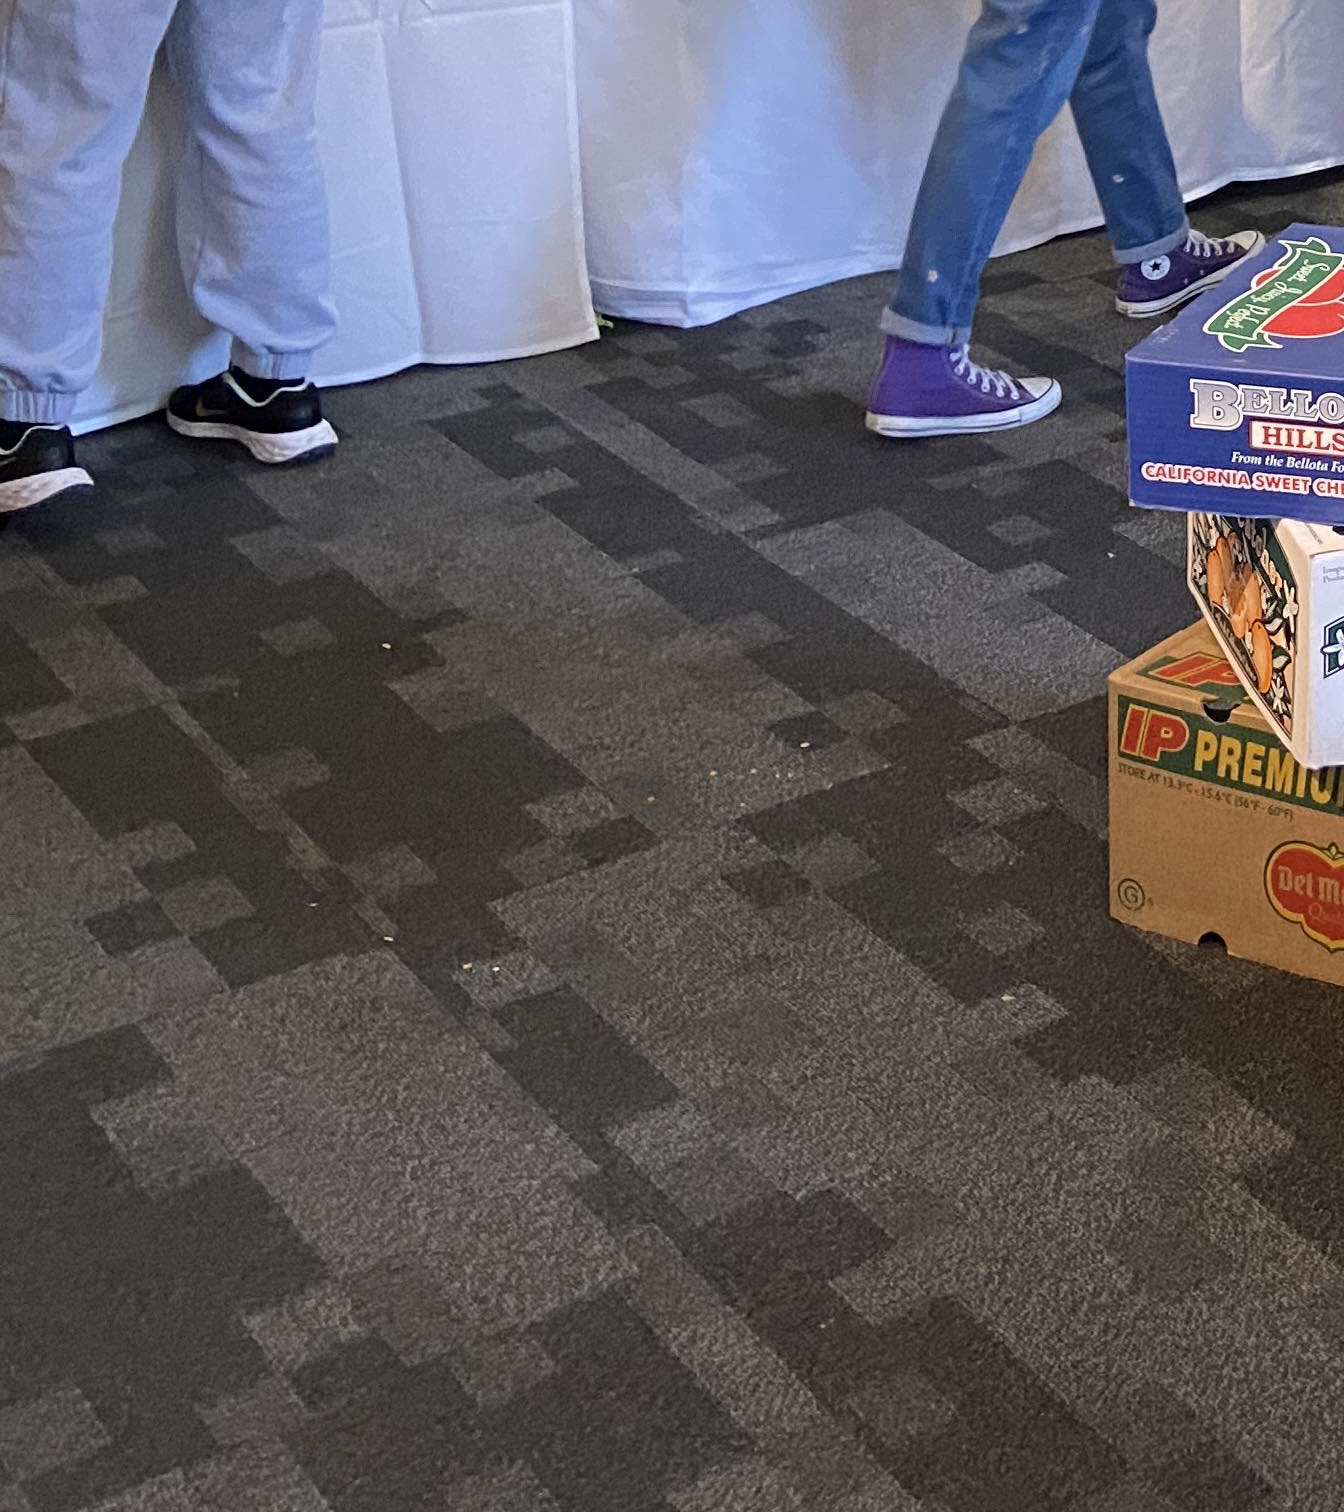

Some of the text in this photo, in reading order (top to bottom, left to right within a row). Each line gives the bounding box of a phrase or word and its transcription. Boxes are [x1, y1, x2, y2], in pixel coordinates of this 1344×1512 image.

[1231, 452, 1262, 465] From
[1265, 455, 1283, 467] the
[1286, 456, 1328, 472] Bellota
[1145, 464, 1249, 486] CALIFORNIA
[1256, 475, 1310, 493] SWEET
[1119, 704, 1190, 762] IP
[1117, 762, 1145, 780] STORE
[1146, 769, 1160, 783] AT
[1277, 865, 1313, 899] Del
